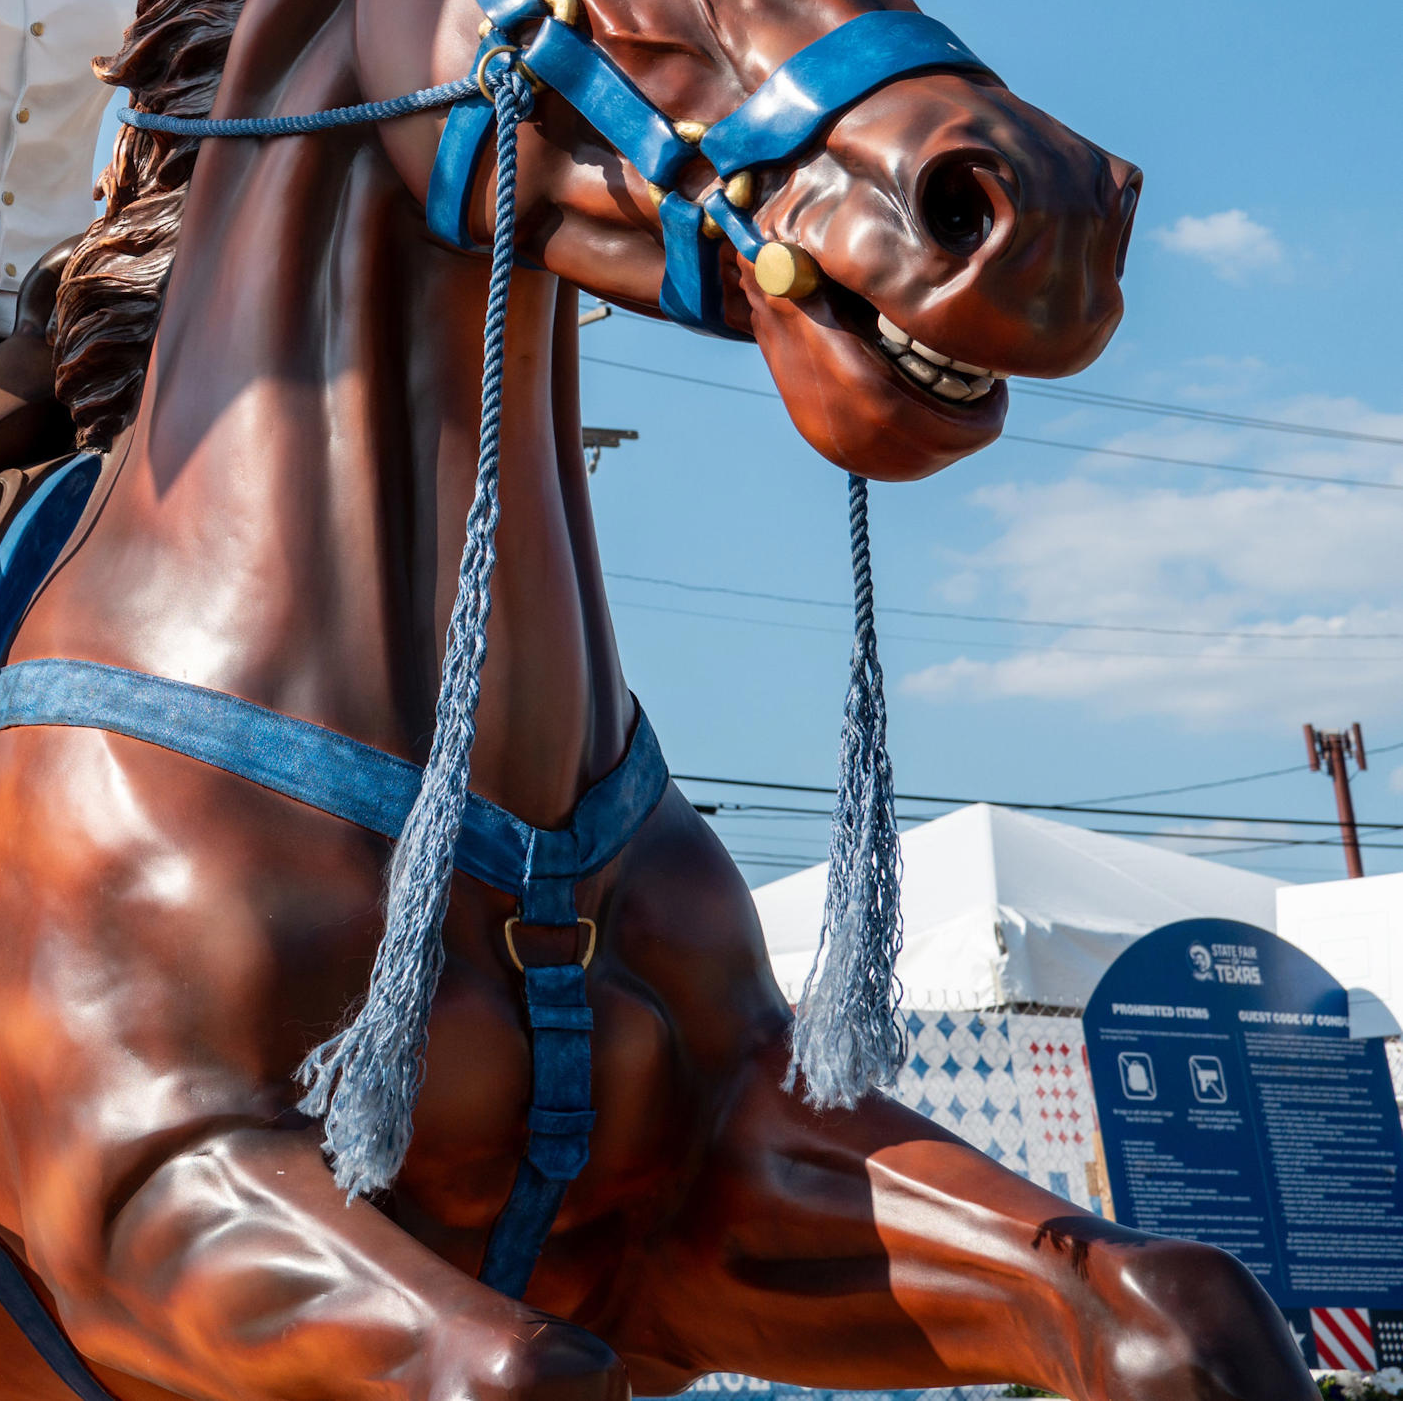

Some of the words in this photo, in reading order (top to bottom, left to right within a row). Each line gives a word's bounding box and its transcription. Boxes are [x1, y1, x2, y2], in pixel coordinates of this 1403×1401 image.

[1211, 944, 1237, 958] STATE
[1111, 1002, 1175, 1018] PROHIBITED
[1175, 1006, 1210, 1020] ITEMS
[1238, 1010, 1272, 1024] GUEST
[1273, 1012, 1301, 1026] CODE
[1301, 1013, 1315, 1027] OF
